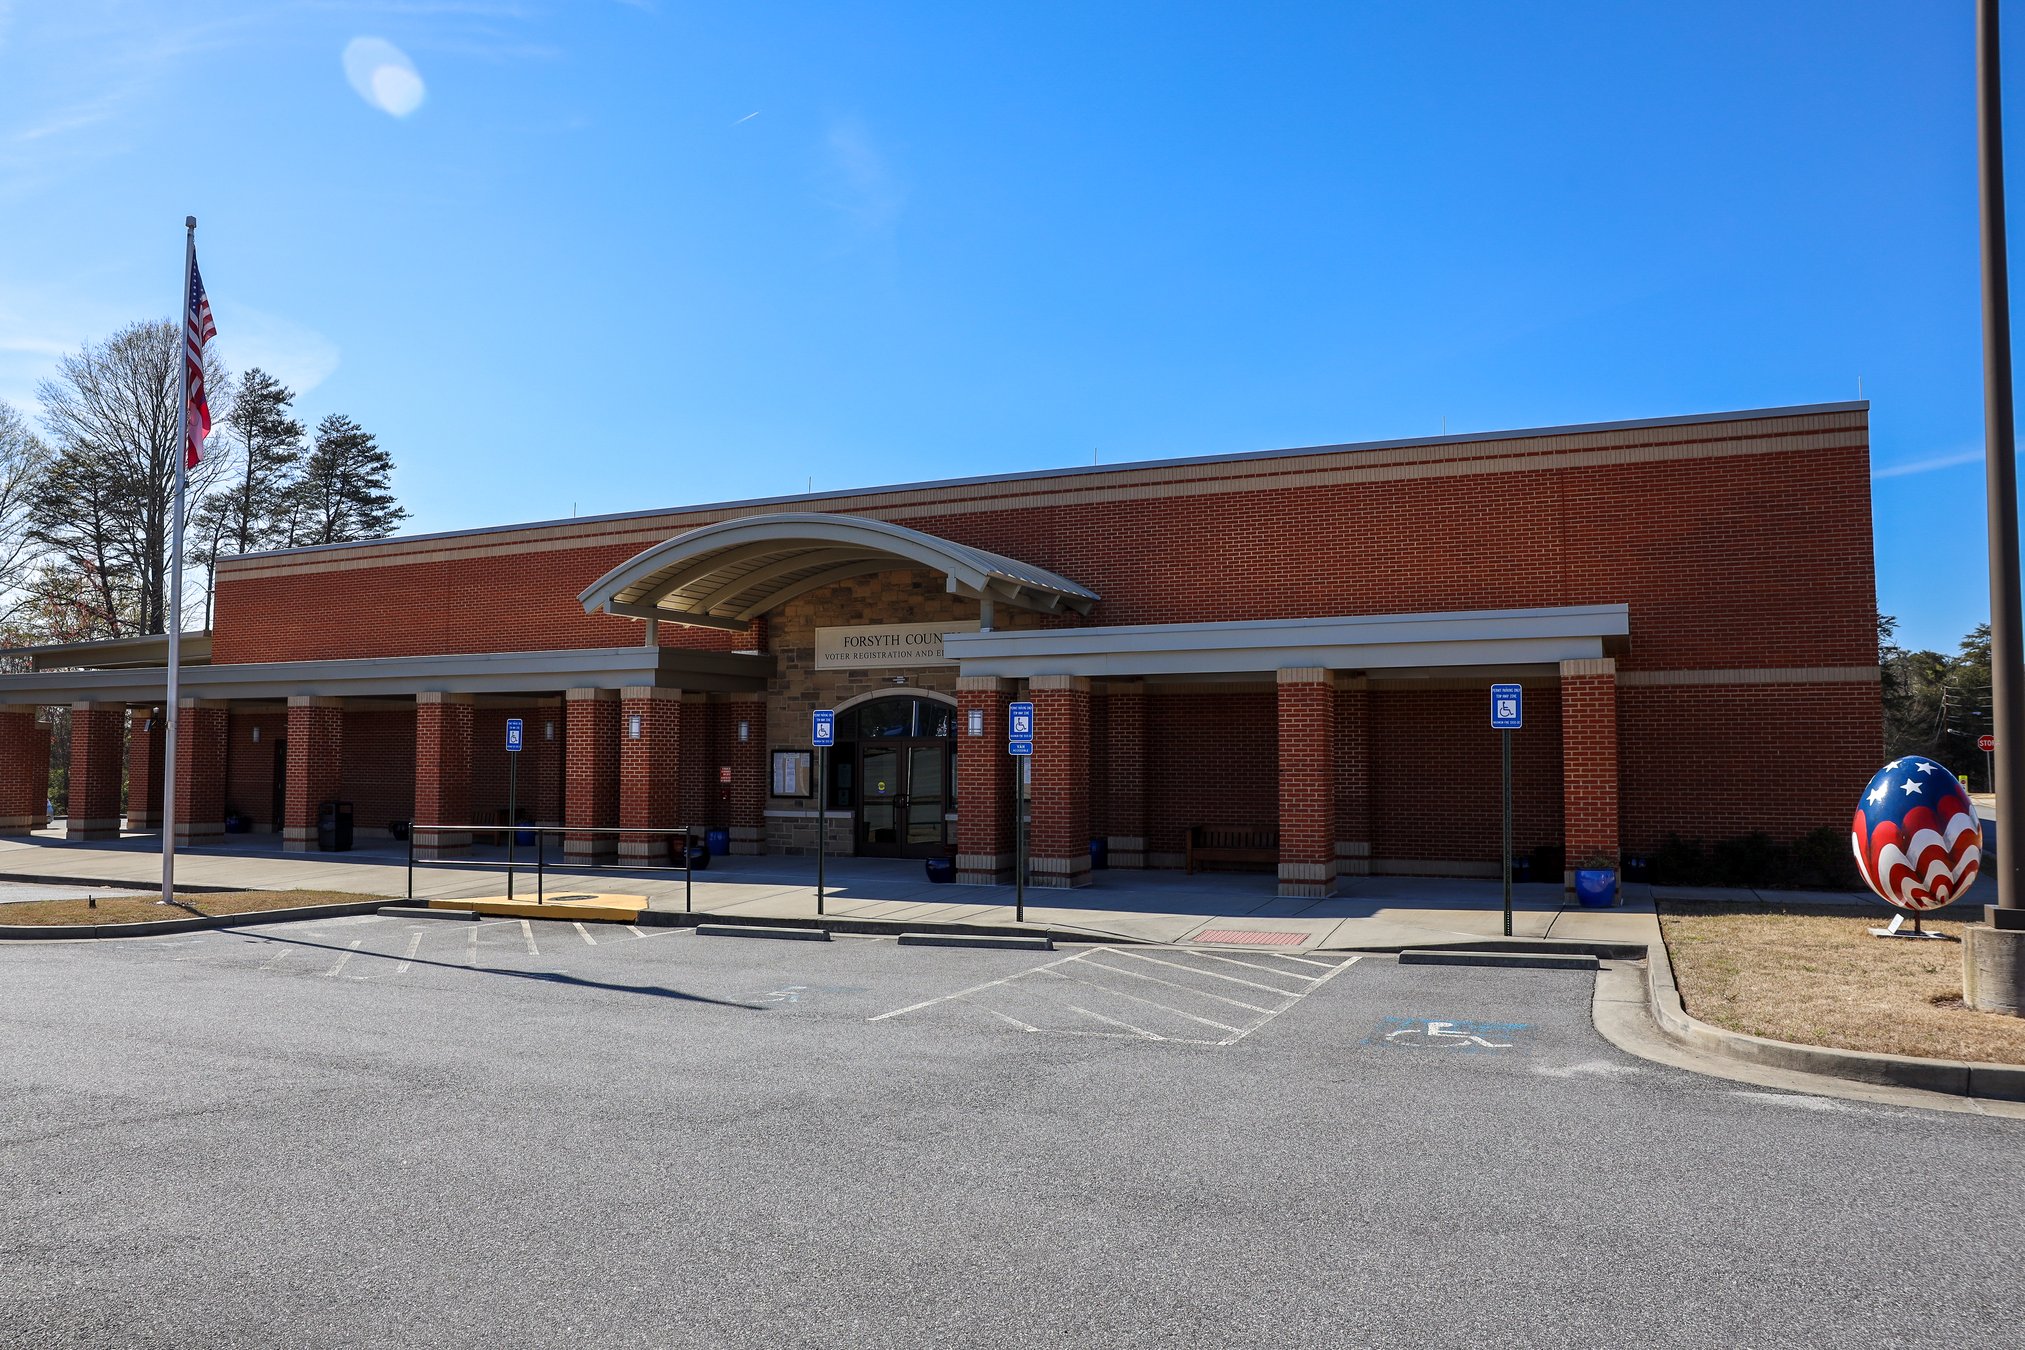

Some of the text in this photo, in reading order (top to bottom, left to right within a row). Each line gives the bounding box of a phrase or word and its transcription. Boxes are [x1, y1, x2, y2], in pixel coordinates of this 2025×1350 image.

[844, 632, 946, 647] FORSYTH COUN
[825, 652, 850, 660] VOTER
[853, 650, 912, 659] REGISTRATION
[915, 649, 934, 657] AND
